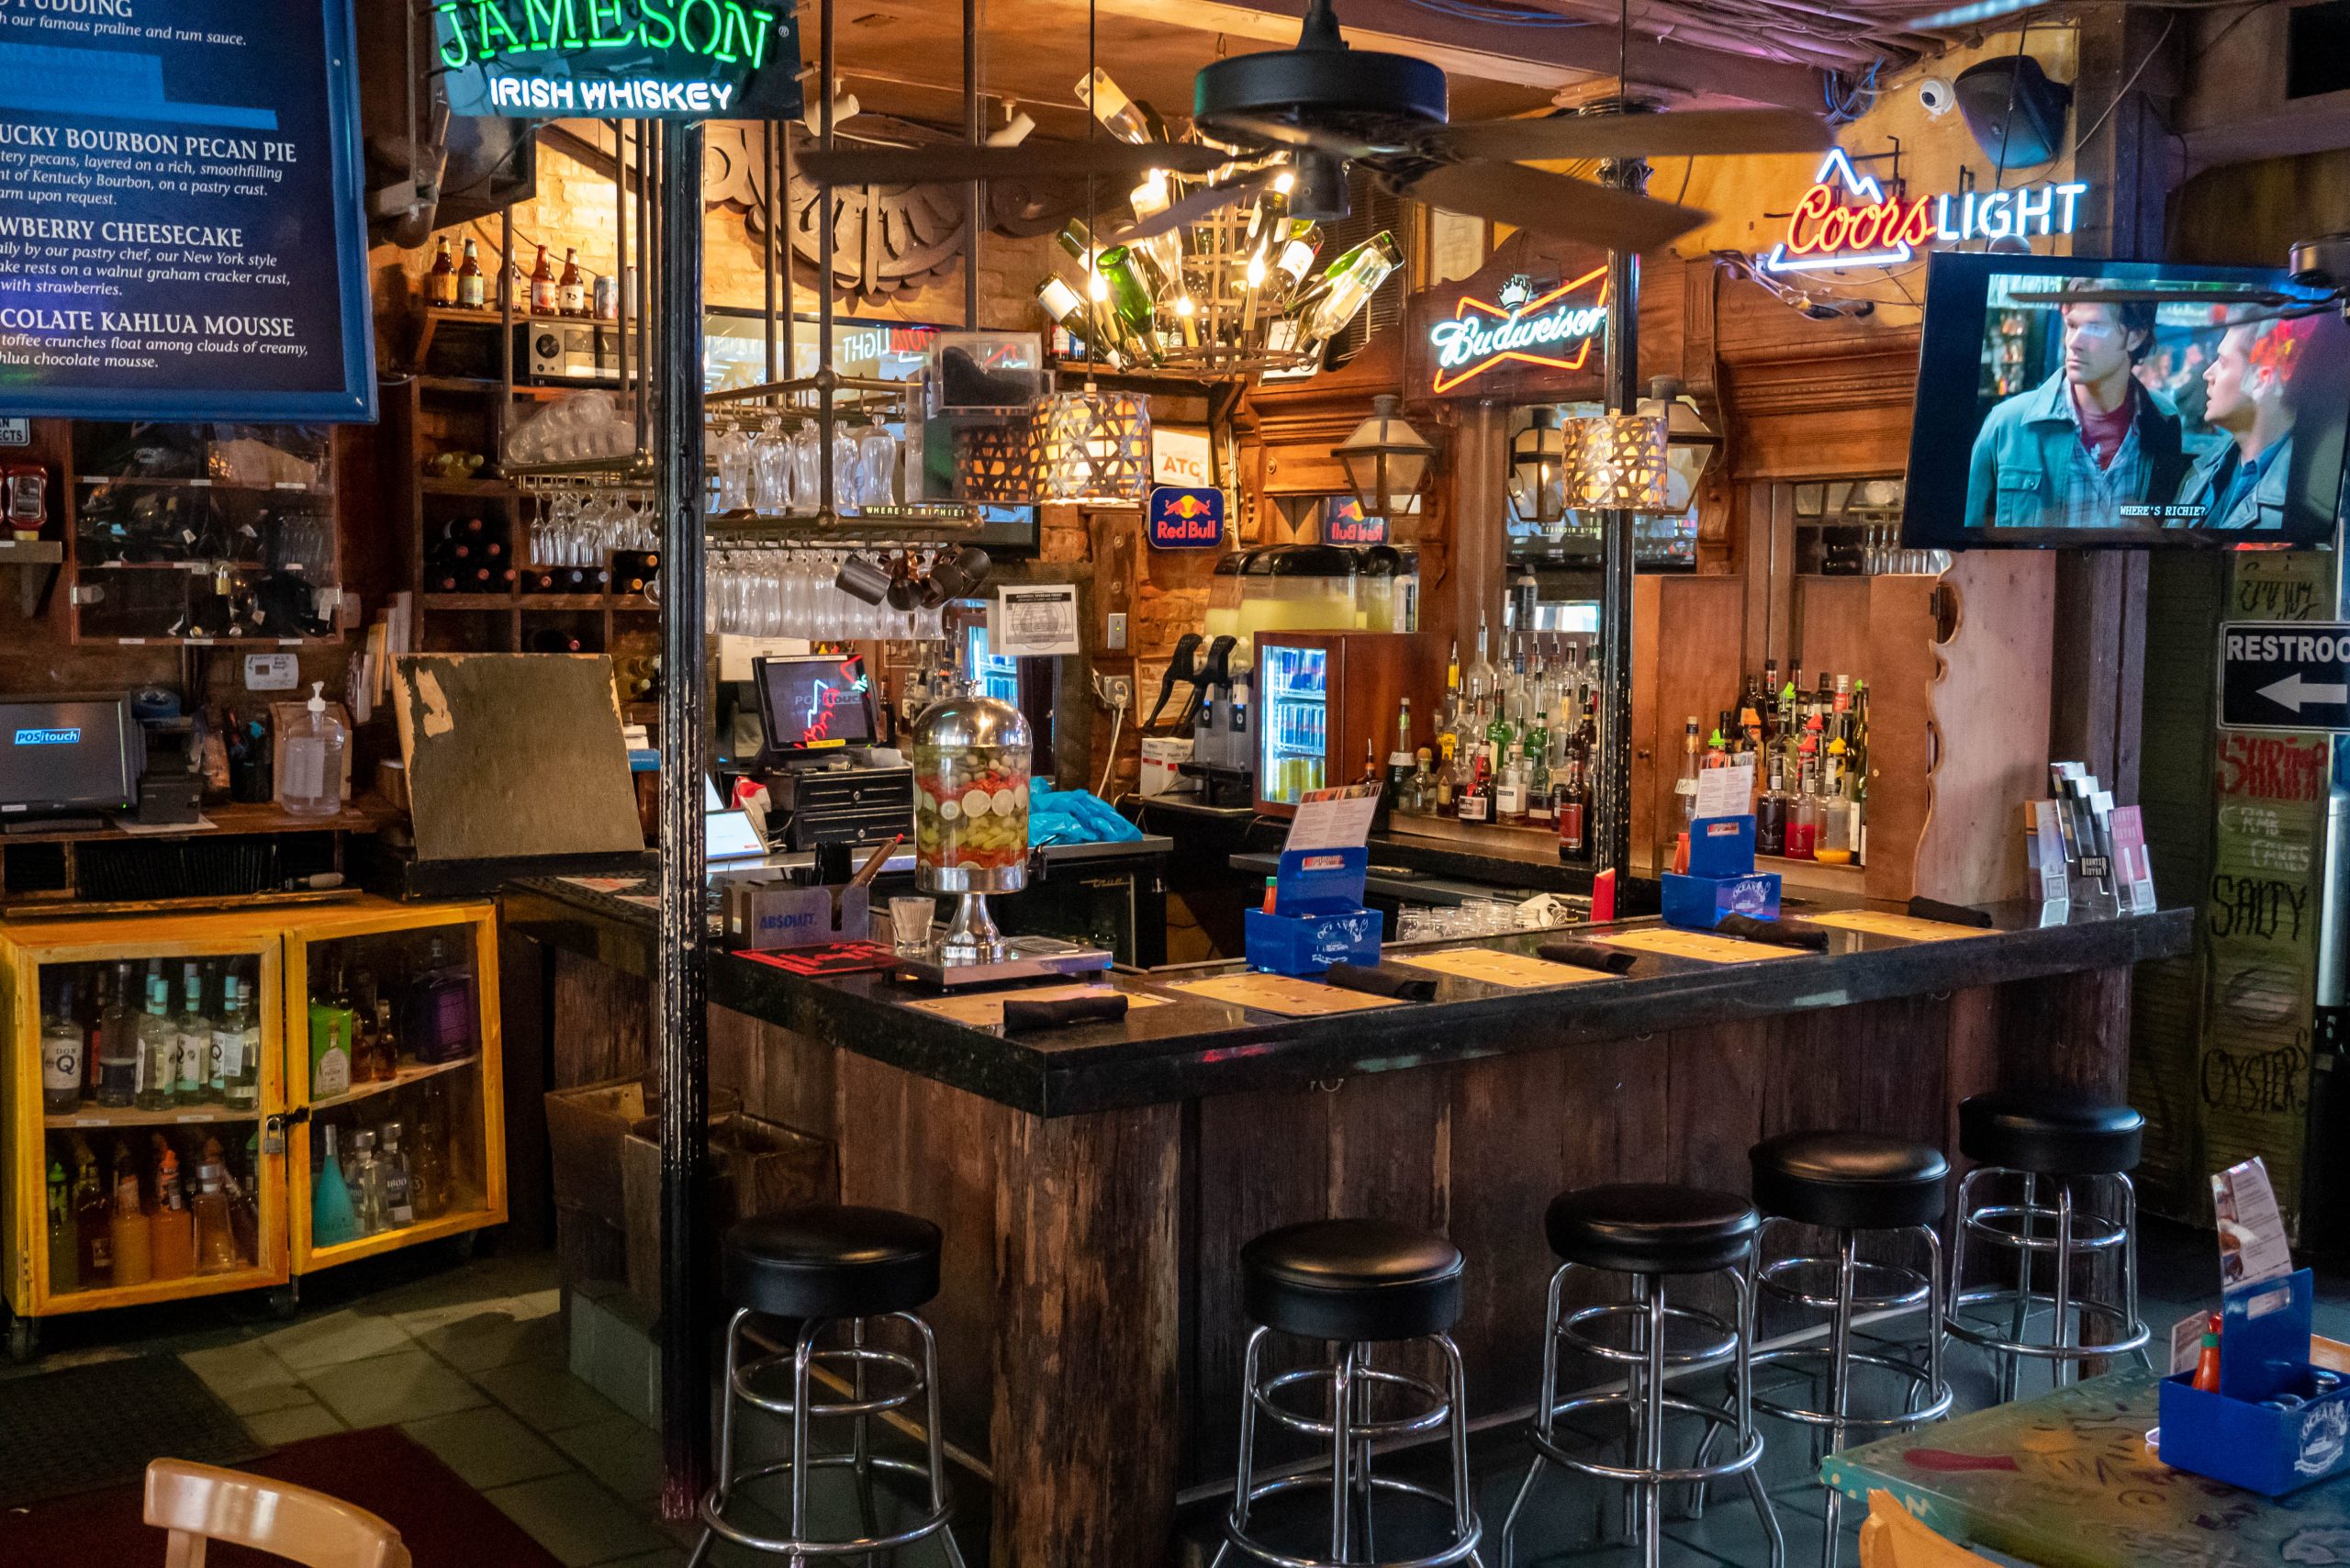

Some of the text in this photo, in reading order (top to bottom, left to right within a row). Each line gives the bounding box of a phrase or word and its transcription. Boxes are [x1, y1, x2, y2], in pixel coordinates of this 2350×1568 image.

[12, 17, 35, 27] our
[39, 16, 90, 31] famous
[94, 22, 140, 36] praline
[146, 27, 172, 39] and
[175, 29, 202, 41] rum
[207, 32, 246, 45] sauce.
[441, 0, 773, 69] JAMESON
[490, 77, 733, 111] IRISH WHISKEY
[0, 123, 297, 162] UCKY BOURBON PECAN PIE
[1, 151, 26, 166] tery
[29, 153, 79, 167] pecans,
[84, 154, 131, 171] layered
[135, 161, 151, 171] on
[155, 162, 163, 172] a
[168, 161, 195, 174] rich,
[15, 169, 30, 182] of
[32, 170, 92, 189] Kentucky
[96, 174, 154, 191] Bourbon,
[159, 181, 174, 190] on
[179, 182, 187, 191] a
[191, 182, 230, 196] pastry
[234, 185, 267, 196] crust.
[28, 191, 62, 204] upon
[66, 193, 118, 207] request.
[0, 217, 243, 248] WBERRY CHEESECAKE
[1786, 183, 2088, 255] Coors LIGHT
[25, 242, 41, 258] by
[46, 246, 69, 257] our
[73, 247, 116, 263] pastry
[119, 248, 151, 263] chef,
[156, 252, 179, 262] our
[184, 251, 212, 263] New
[217, 252, 245, 265] York
[248, 254, 277, 269] style
[1, 279, 123, 296] with strawberries.
[25, 263, 57, 274] rests
[61, 265, 79, 275] on
[83, 266, 92, 275] a
[96, 265, 143, 278] walnut
[147, 267, 200, 282] graham
[204, 270, 252, 283] cracker
[255, 273, 290, 286] crust,
[1, 308, 296, 337] COLATE KAHLUA MOUSSE
[2, 333, 308, 358] toffee crunches float among clouds of creamy,
[1431, 305, 1607, 368] Budweiser
[34, 353, 100, 366] chocolate
[105, 357, 158, 368] mousse.
[866, 506, 912, 516] WHERE'S
[2120, 505, 2206, 516] WHERE'S RICHIE?
[1157, 520, 1216, 540] Red Bull
[2226, 635, 2350, 662] RESTROO
